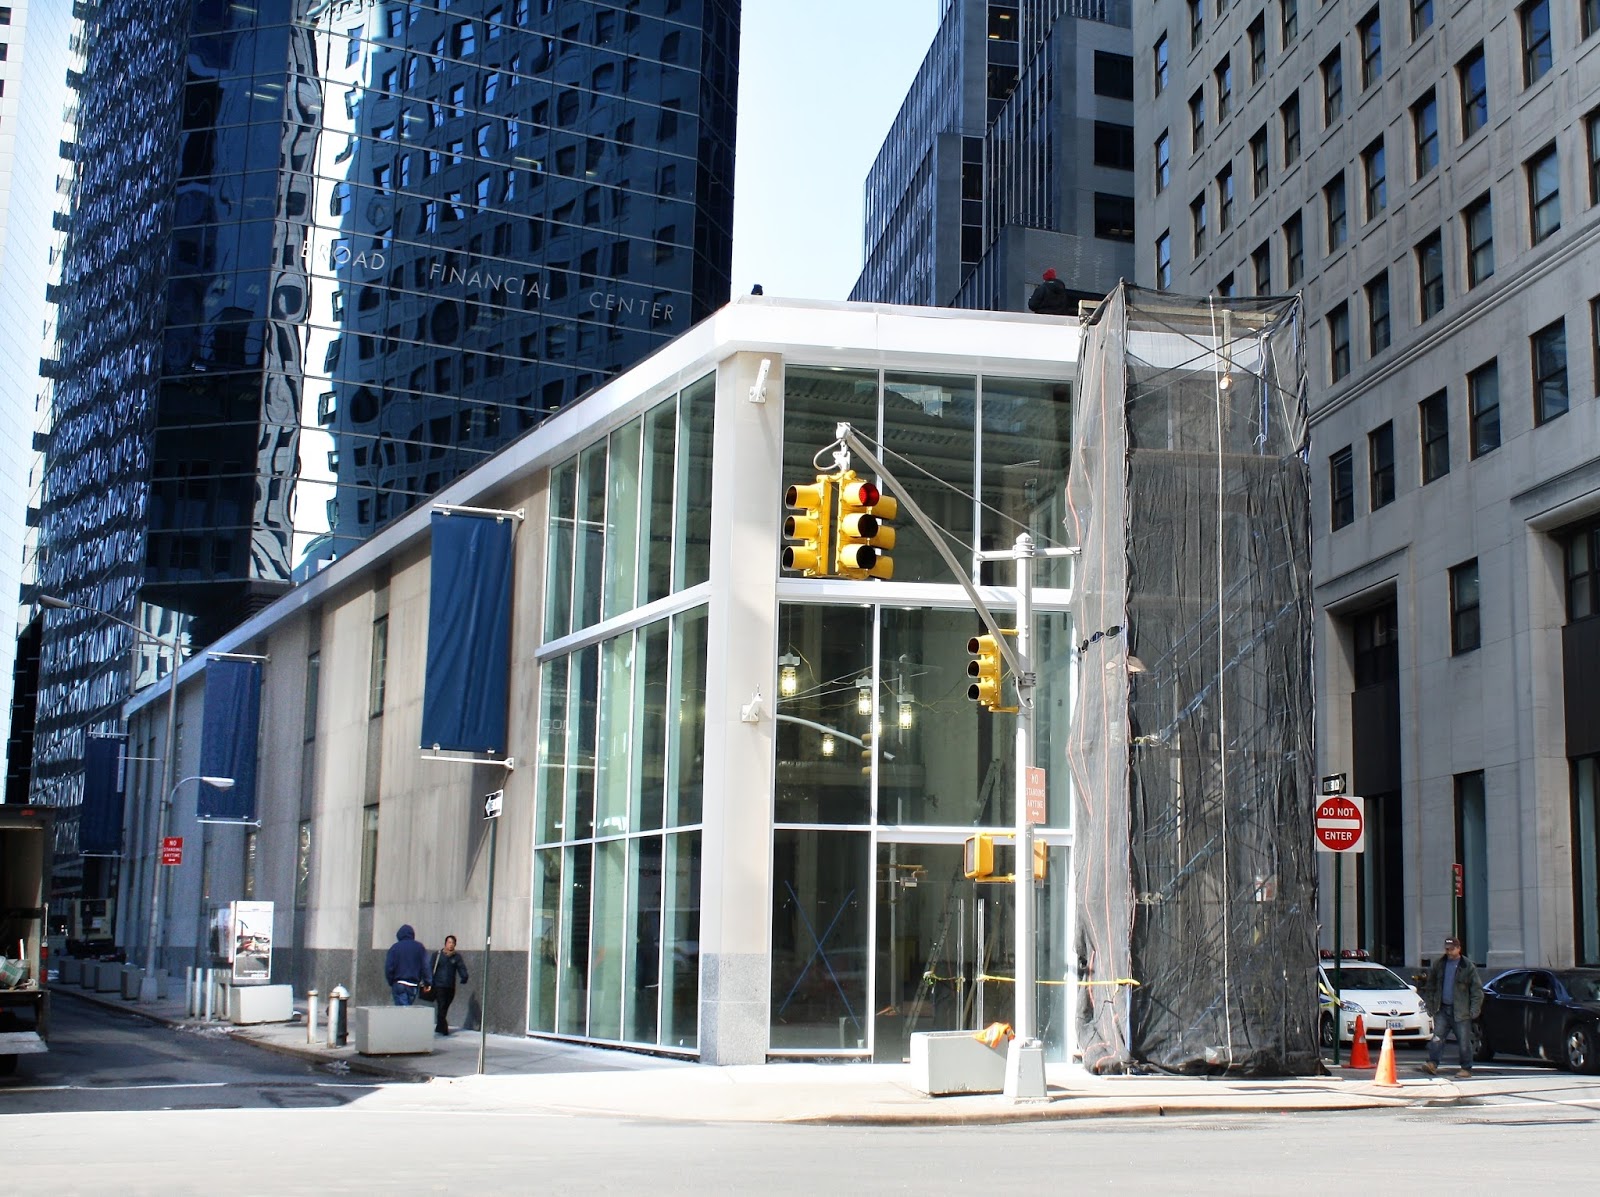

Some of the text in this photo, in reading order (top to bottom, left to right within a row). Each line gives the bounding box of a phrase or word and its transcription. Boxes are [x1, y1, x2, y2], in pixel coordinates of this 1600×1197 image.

[301, 241, 674, 321] BROAD FINANCIAL CENTER
[1031, 773, 1039, 785] NO
[1322, 807, 1355, 817] DO NOT
[1324, 831, 1353, 841] ENTER
